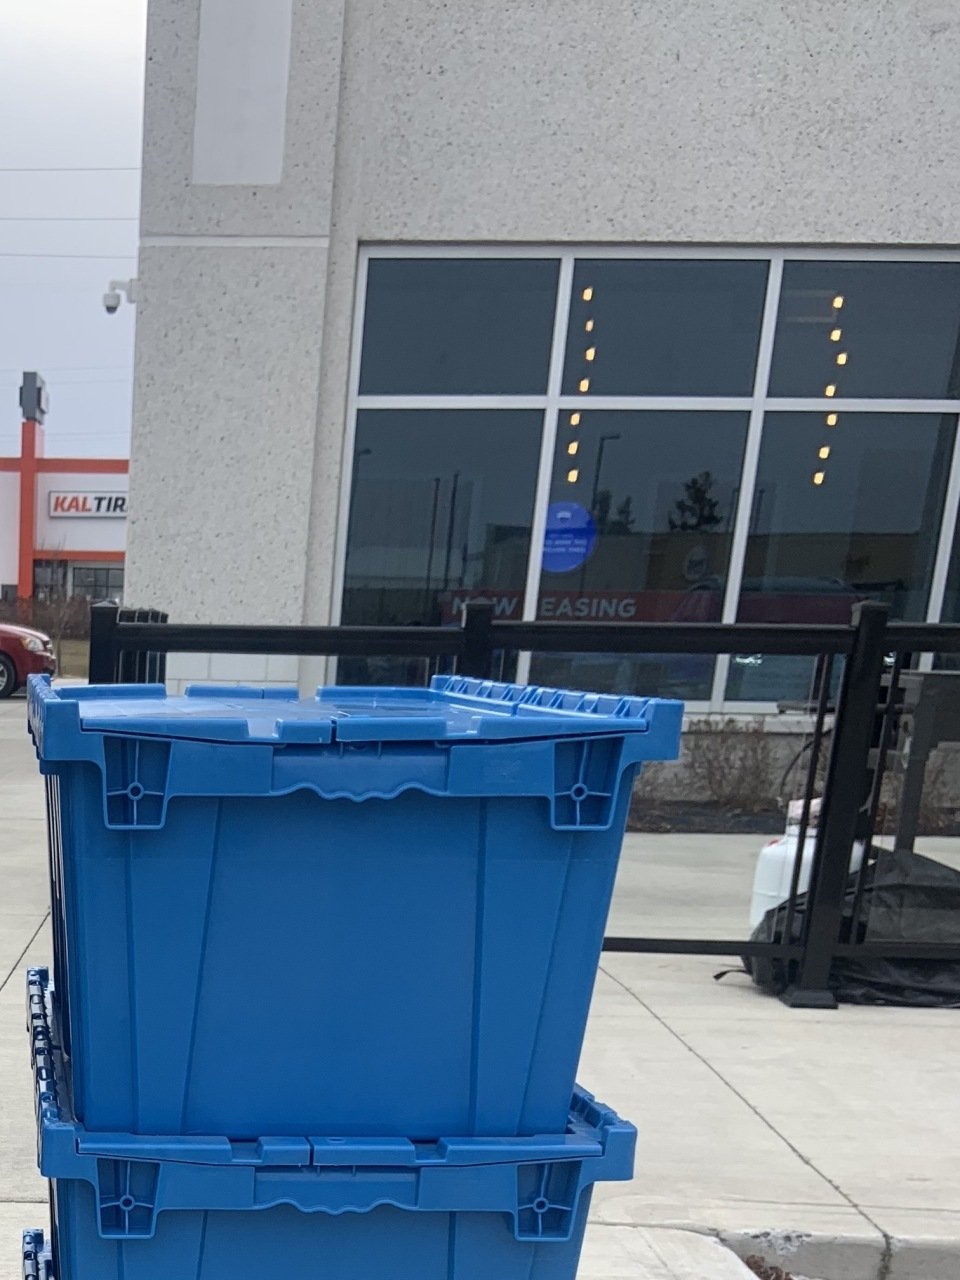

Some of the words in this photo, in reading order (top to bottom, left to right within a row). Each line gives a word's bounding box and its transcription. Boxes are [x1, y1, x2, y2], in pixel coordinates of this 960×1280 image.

[53, 495, 92, 513] KAL
[94, 495, 129, 513] TIR
[540, 597, 637, 617] EASING
